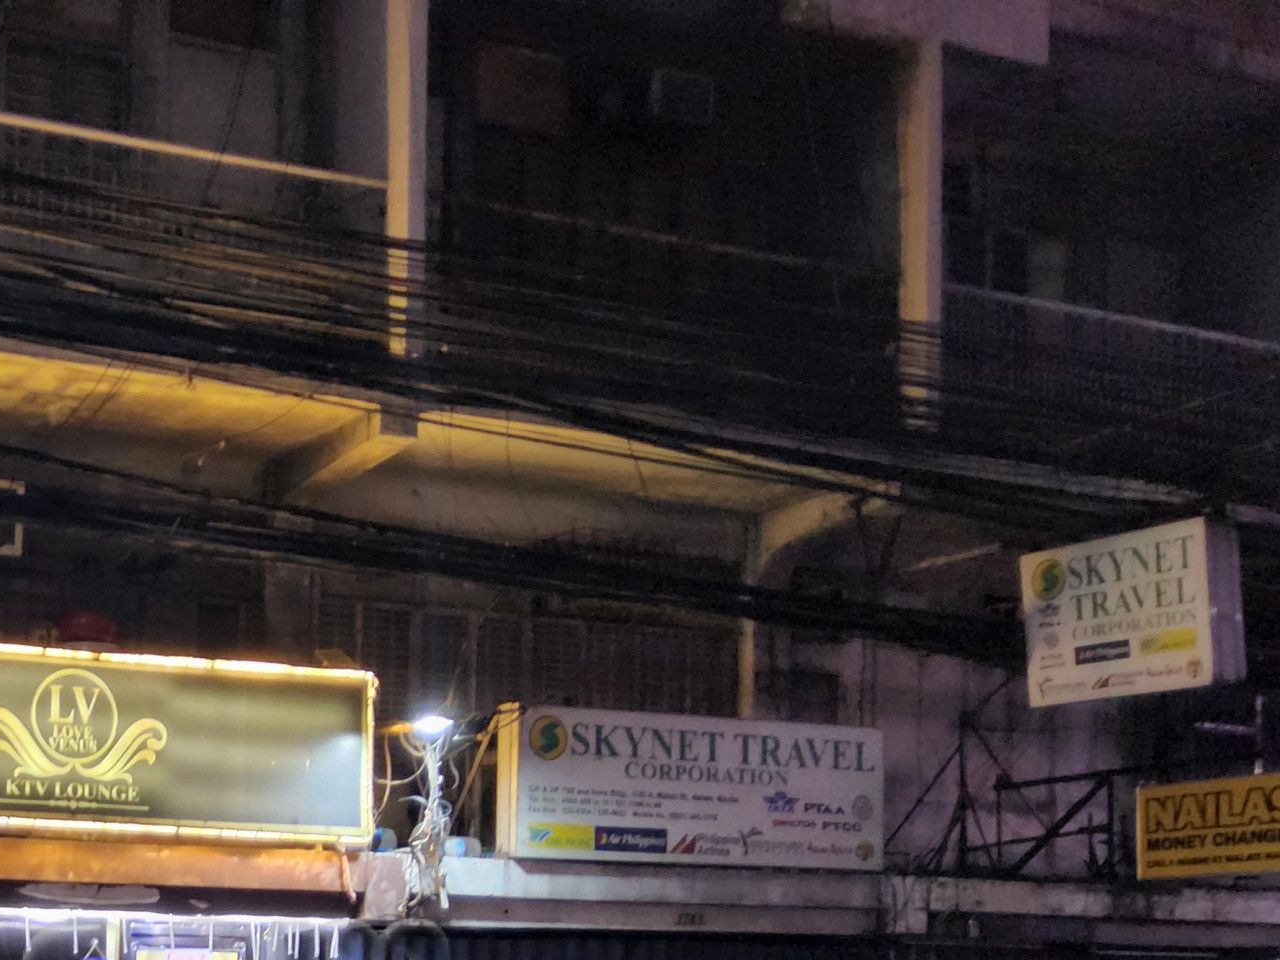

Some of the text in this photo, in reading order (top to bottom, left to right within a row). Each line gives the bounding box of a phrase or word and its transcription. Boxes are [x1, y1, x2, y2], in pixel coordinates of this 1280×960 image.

[1068, 535, 1194, 590] SKYNET
[1070, 577, 1196, 621] TRAVEL
[1072, 609, 1197, 640] CORPORATION
[49, 684, 100, 724] LV
[53, 725, 94, 738] LOVE
[49, 737, 97, 752] VENUS
[571, 722, 875, 772] SKYNET TRAVEL
[625, 761, 788, 786] CORPORATION
[6, 779, 49, 796] KTV
[55, 781, 140, 802] LOUNGE
[1147, 834, 1207, 851] MONEY
[1212, 828, 1280, 847] CHANG
